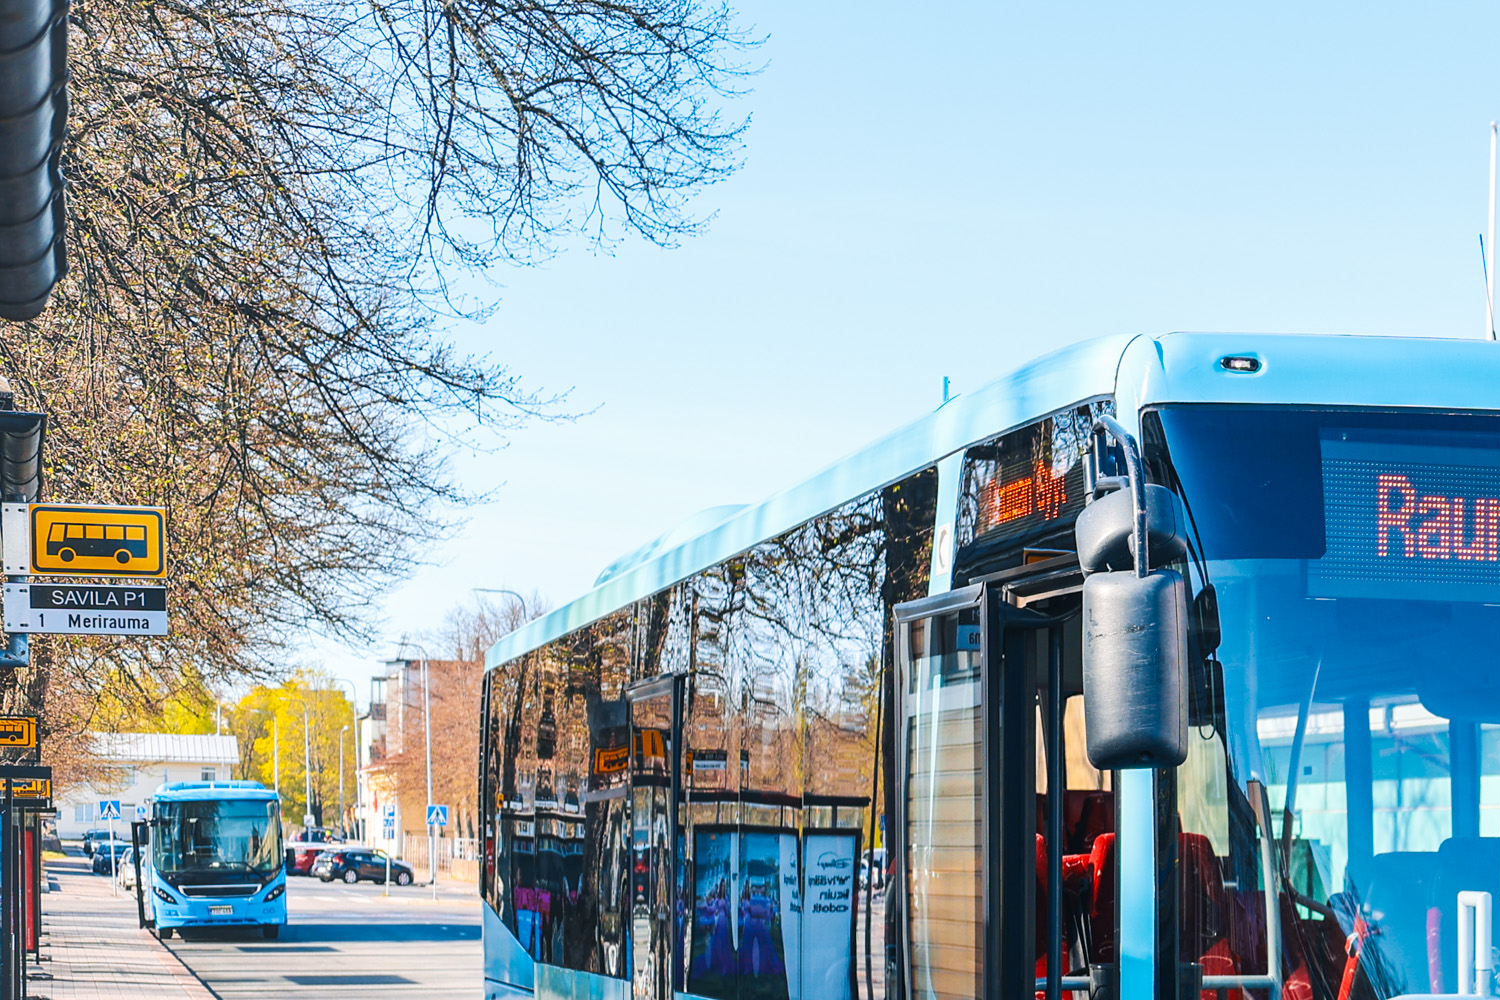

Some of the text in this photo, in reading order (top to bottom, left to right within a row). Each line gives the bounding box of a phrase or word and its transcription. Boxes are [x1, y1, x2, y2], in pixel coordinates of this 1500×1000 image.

[51, 589, 146, 607] SAVILA P1
[38, 612, 150, 630] 1 Merirauma
